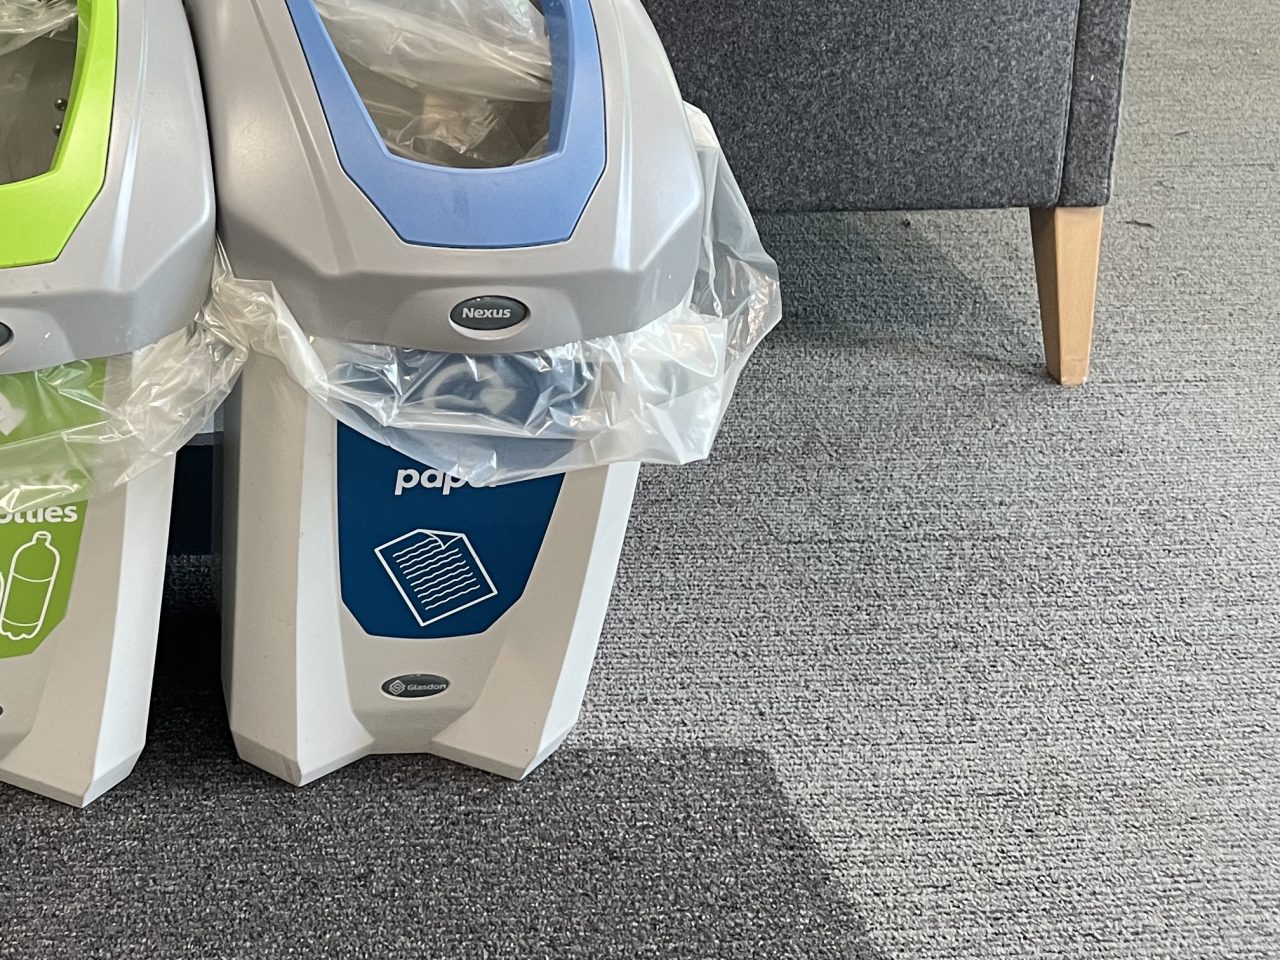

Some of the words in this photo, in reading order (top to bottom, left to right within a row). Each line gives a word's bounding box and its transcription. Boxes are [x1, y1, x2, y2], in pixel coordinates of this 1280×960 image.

[463, 308, 510, 318] Nexus
[394, 469, 497, 495] pap
[407, 682, 447, 691] Glasdon
